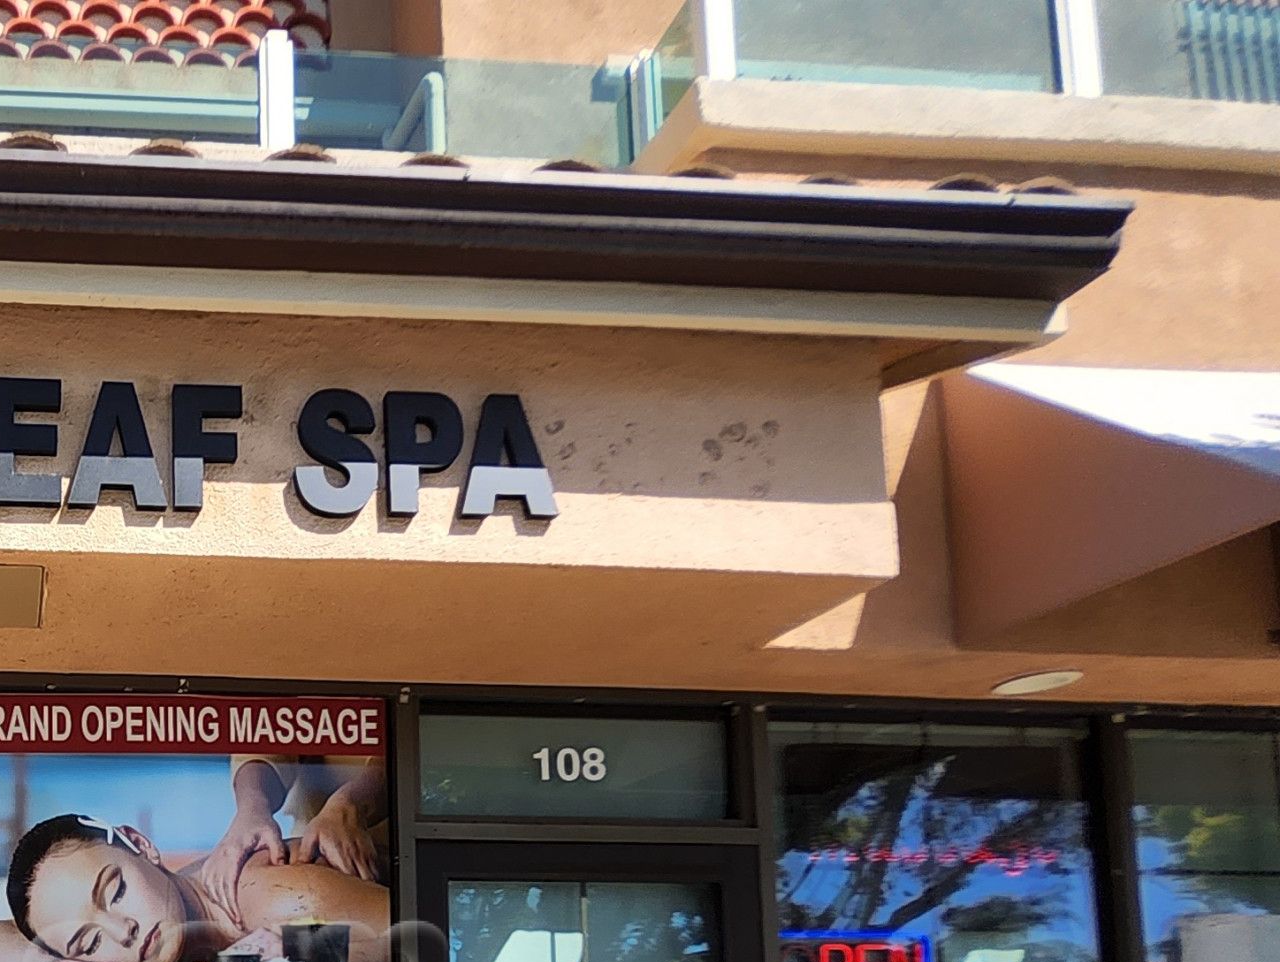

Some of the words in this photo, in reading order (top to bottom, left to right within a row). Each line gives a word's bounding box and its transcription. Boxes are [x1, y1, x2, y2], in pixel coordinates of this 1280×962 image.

[293, 388, 558, 518] SPA
[81, 705, 220, 743] OPENING
[229, 707, 379, 745] MASSAGE
[532, 747, 607, 782] 108
